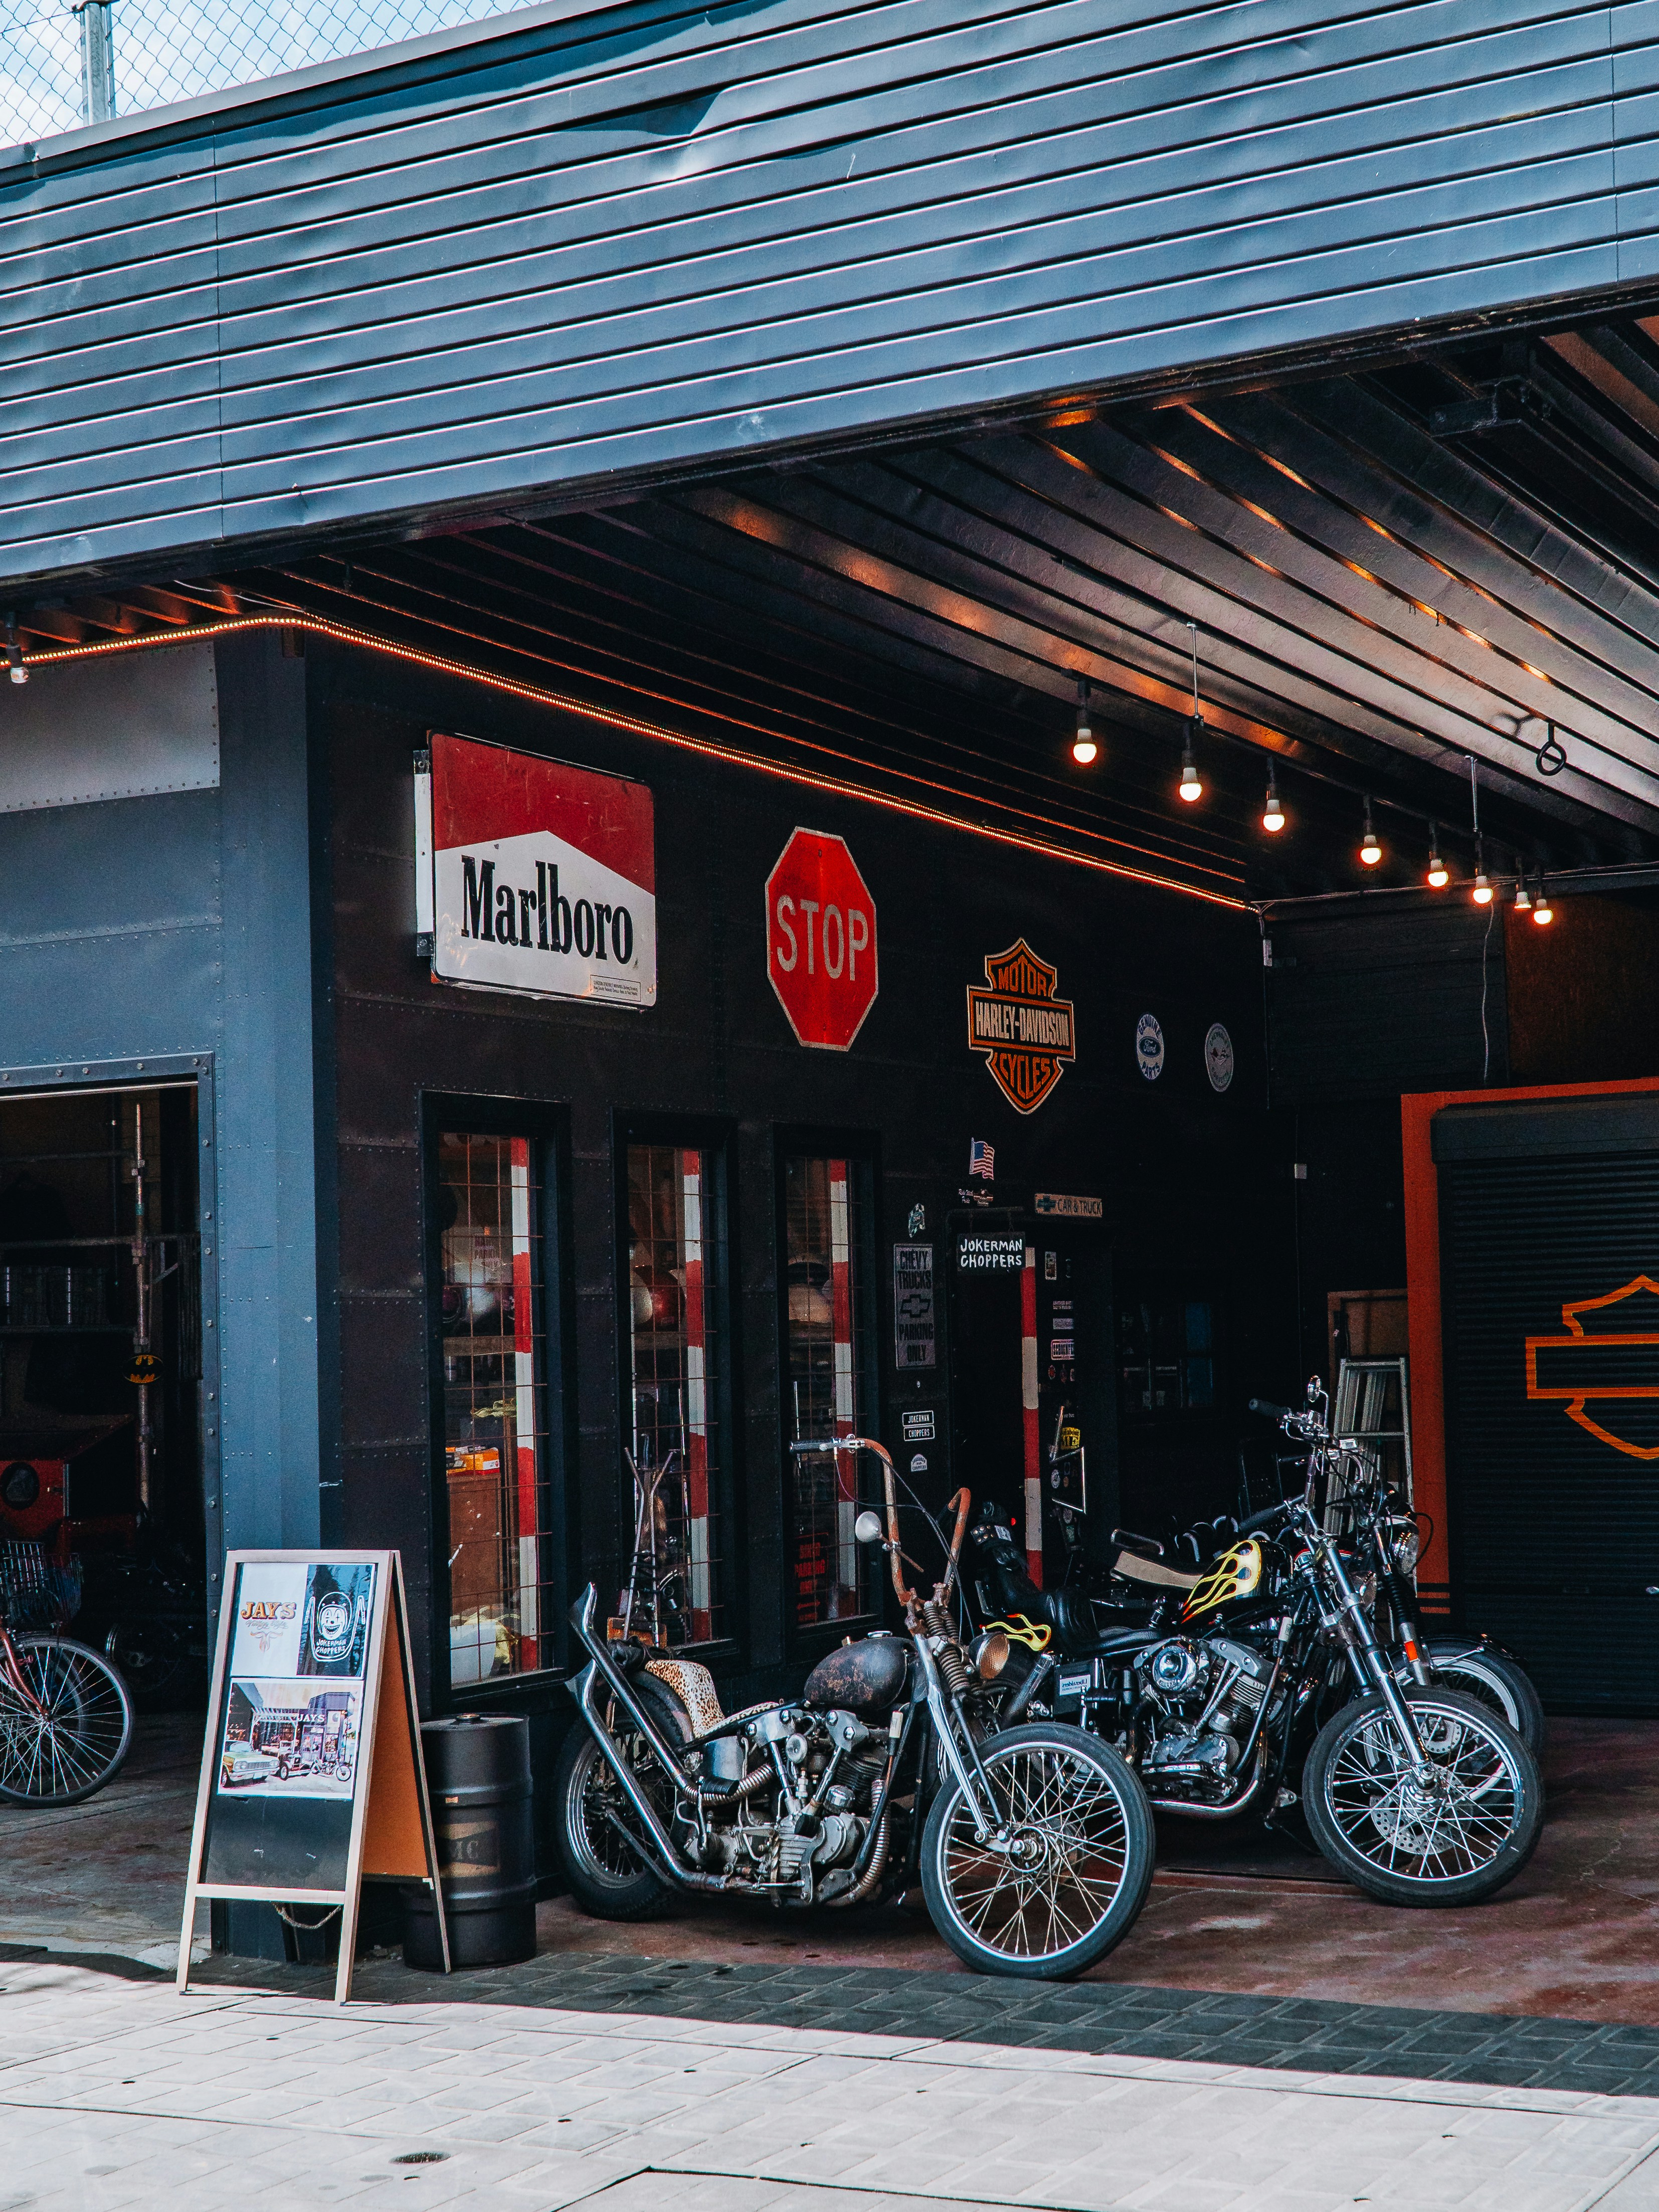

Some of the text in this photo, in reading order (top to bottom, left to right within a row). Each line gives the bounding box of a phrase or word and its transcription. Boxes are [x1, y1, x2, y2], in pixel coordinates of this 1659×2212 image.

[461, 855, 633, 965] Marlboro
[776, 895, 868, 981] STOP
[998, 954, 1047, 996] MOTOR
[976, 1001, 1069, 1047] HARLEY-DAVIDSON
[1143, 1039, 1157, 1053] Ford
[1000, 1053, 1050, 1099] CYCLES
[1142, 1060, 1161, 1079] PARTS
[1057, 1199, 1071, 1212] CAR
[1073, 1200, 1078, 1213] &
[1079, 1200, 1102, 1214] TRUCK
[960, 1238, 1022, 1252] JOKERMAN
[899, 1250, 928, 1270] CHEVY
[961, 1254, 1022, 1268] CHOPPERS
[897, 1270, 932, 1289] TRUCKS
[899, 1323, 934, 1340] PARKING
[907, 1344, 927, 1361] ONLY
[908, 1414, 930, 1423] JOKERMAN
[908, 1428, 930, 1438] CHOPPERS
[241, 1601, 297, 1619] JAYS
[315, 1645, 346, 1655] CHOPPERS
[316, 1638, 347, 1647] JOKERMAN
[298, 1714, 325, 1723] JAYS
